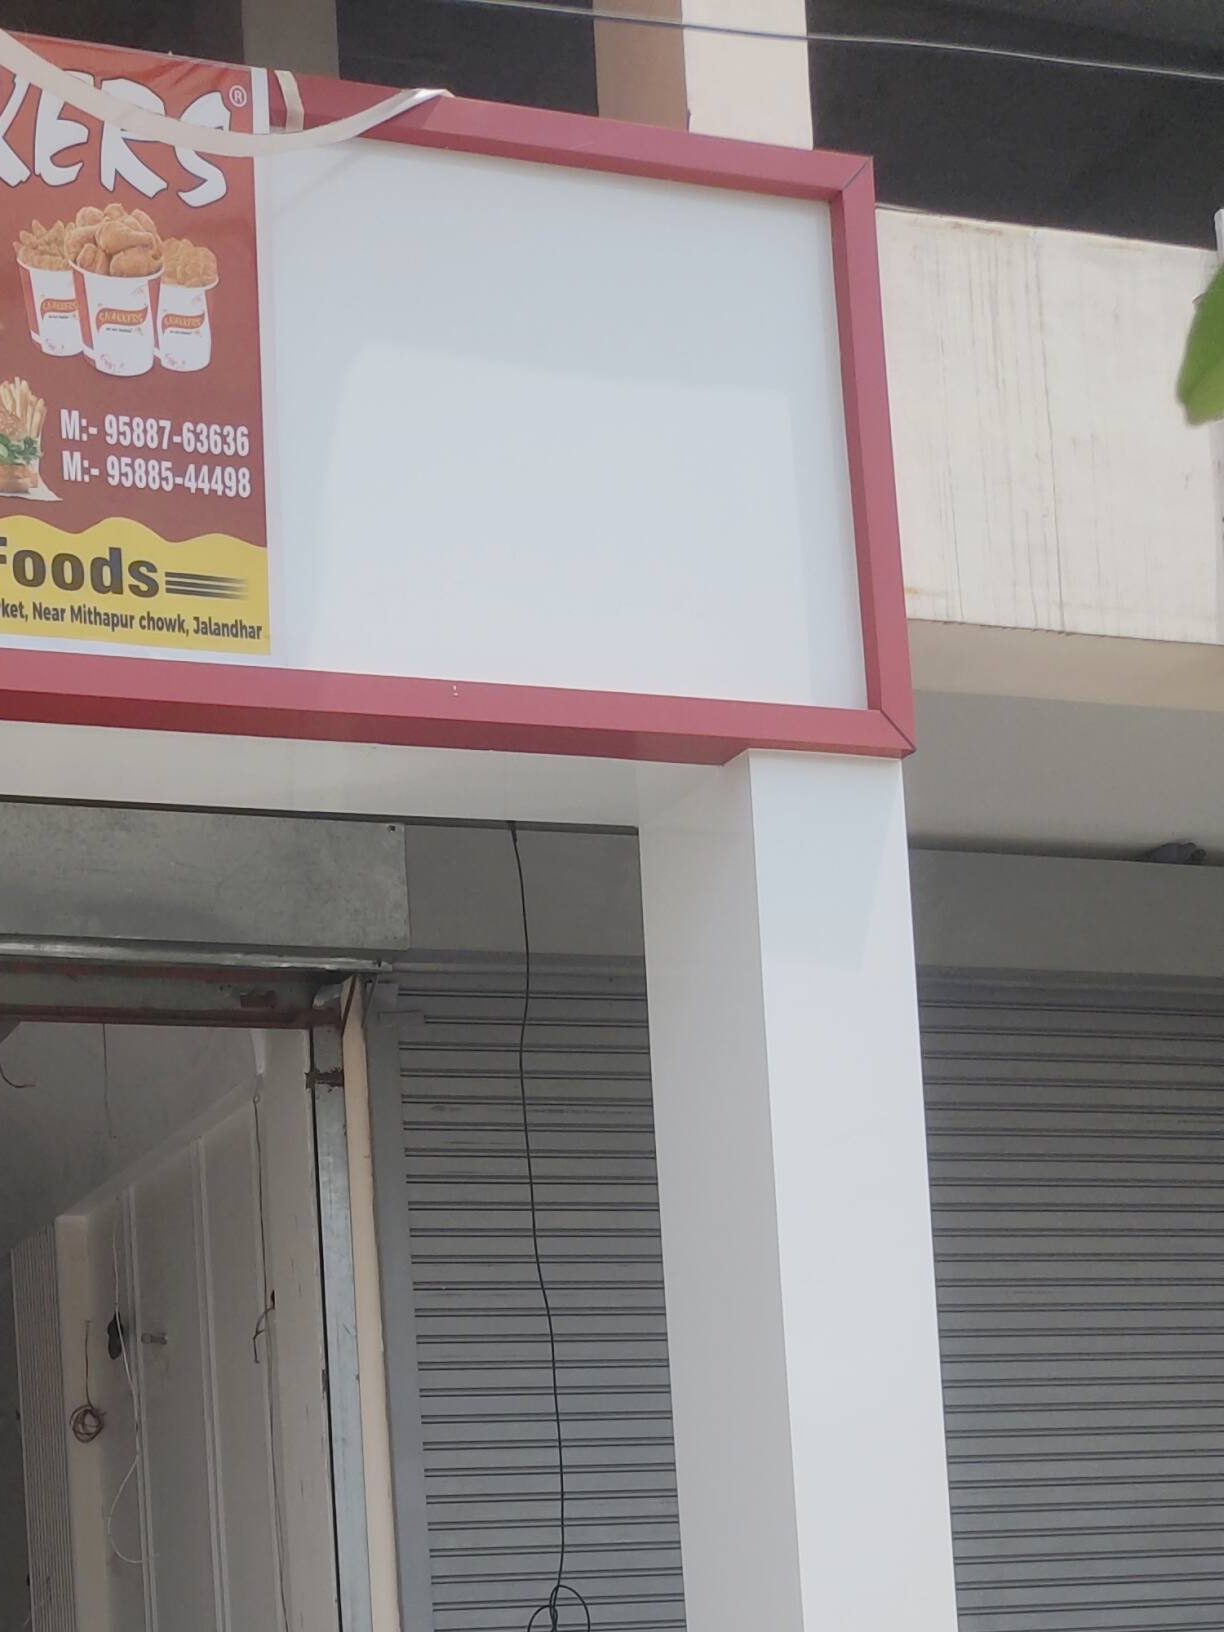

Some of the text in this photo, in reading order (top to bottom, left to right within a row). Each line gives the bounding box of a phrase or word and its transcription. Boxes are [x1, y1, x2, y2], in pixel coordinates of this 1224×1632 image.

[60, 409, 250, 457] M:- 95887-63636
[62, 450, 252, 498] M:- 95885-44498
[32, 601, 66, 623] Near
[70, 604, 135, 632] Mithapur
[139, 611, 189, 637] chowk,
[193, 616, 263, 640] Jalandhar
